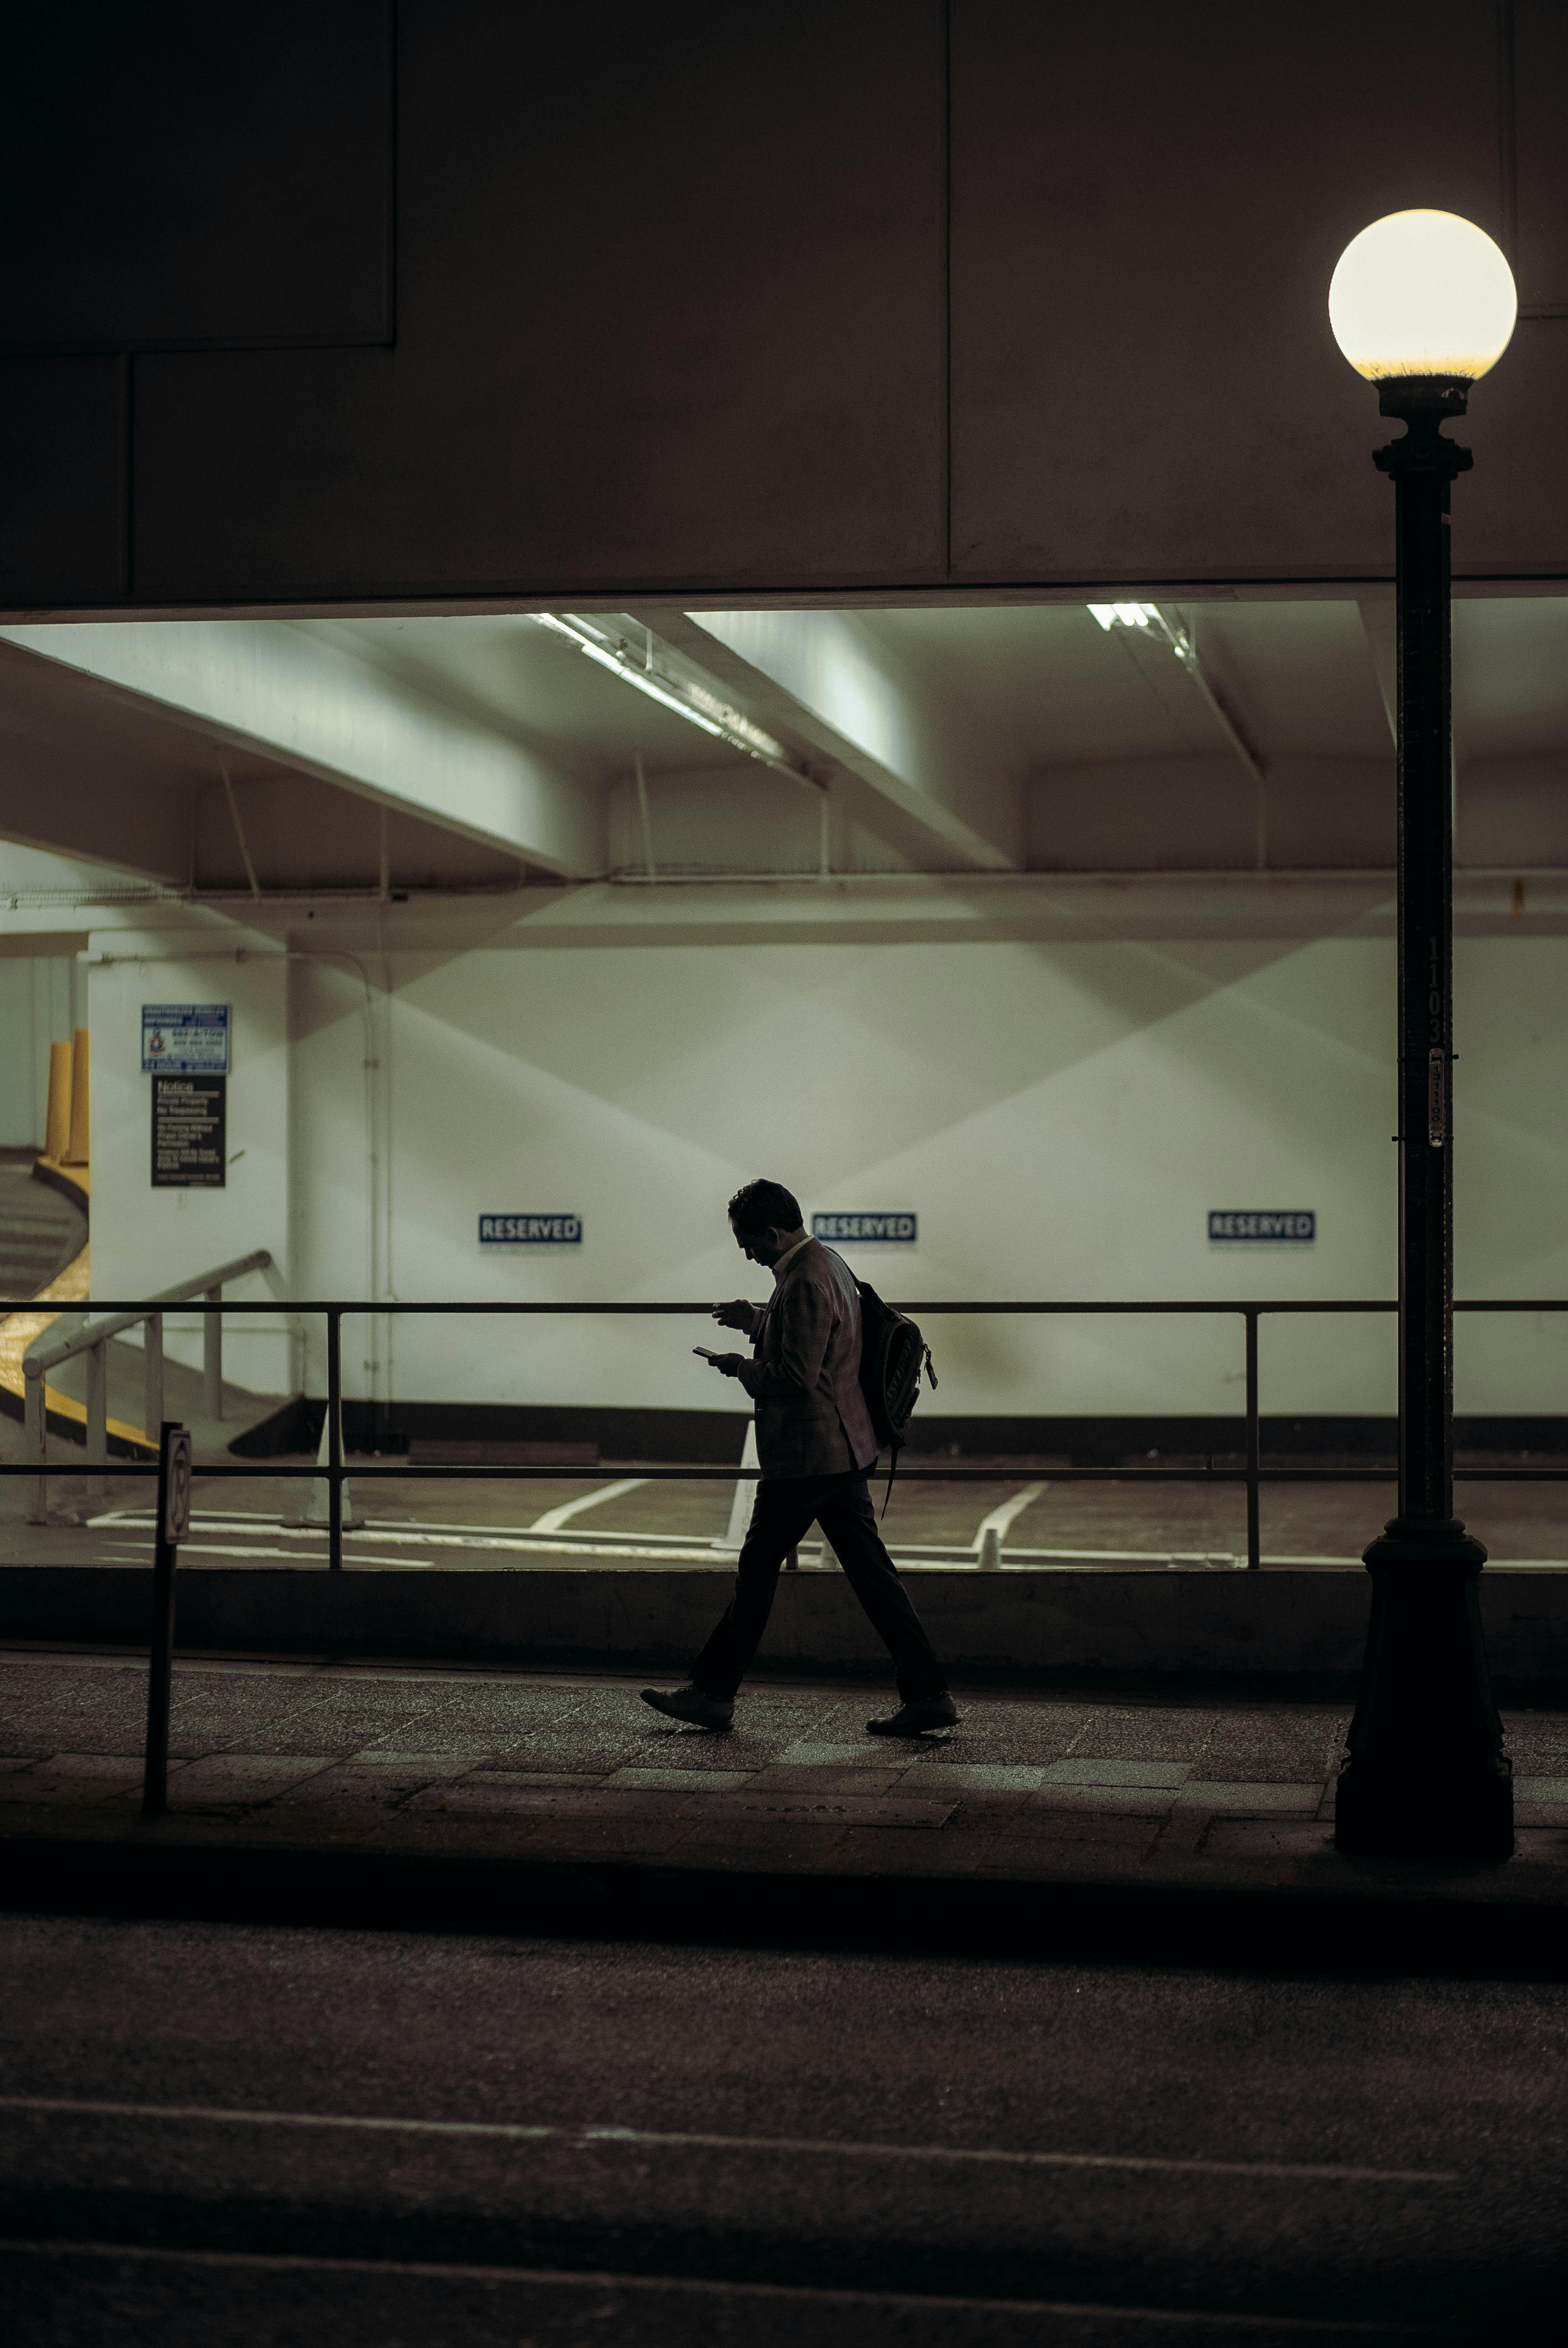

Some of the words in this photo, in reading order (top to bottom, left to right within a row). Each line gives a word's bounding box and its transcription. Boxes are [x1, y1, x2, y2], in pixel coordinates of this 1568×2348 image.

[1428, 936, 1441, 1043] 1103
[482, 1218, 579, 1239] RESERVED
[815, 1217, 914, 1238] RESERVED
[1212, 1215, 1312, 1236] RESERVED
